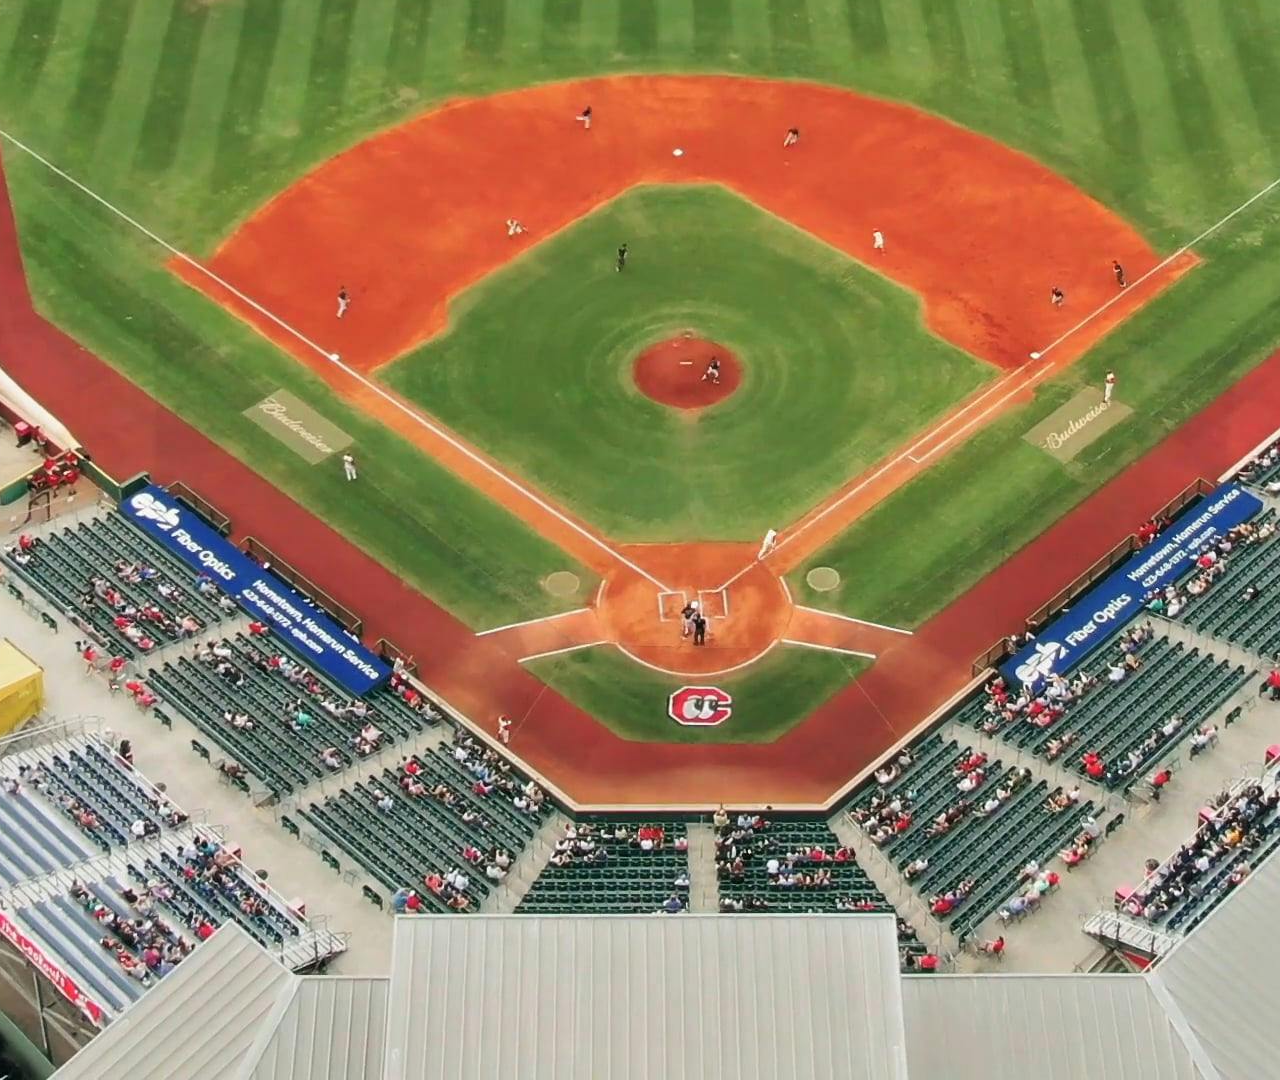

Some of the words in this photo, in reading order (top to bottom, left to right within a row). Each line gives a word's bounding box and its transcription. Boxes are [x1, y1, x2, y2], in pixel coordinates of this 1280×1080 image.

[258, 397, 336, 454] Budweiser
[1042, 400, 1112, 450] Budweiser
[131, 492, 180, 531] epb
[171, 528, 203, 555] Fiber
[198, 550, 236, 581] Optics
[1127, 542, 1176, 582] Hometown,
[1174, 512, 1212, 546] Homerun
[1208, 487, 1241, 519] Service
[252, 579, 304, 623] Hometown,
[303, 617, 346, 655] Homerun
[342, 648, 380, 680] Service
[1015, 640, 1070, 683] epb
[1065, 619, 1097, 647] Fiber
[1093, 592, 1132, 624] Optics
[20, 937, 66, 988] Lookouts
